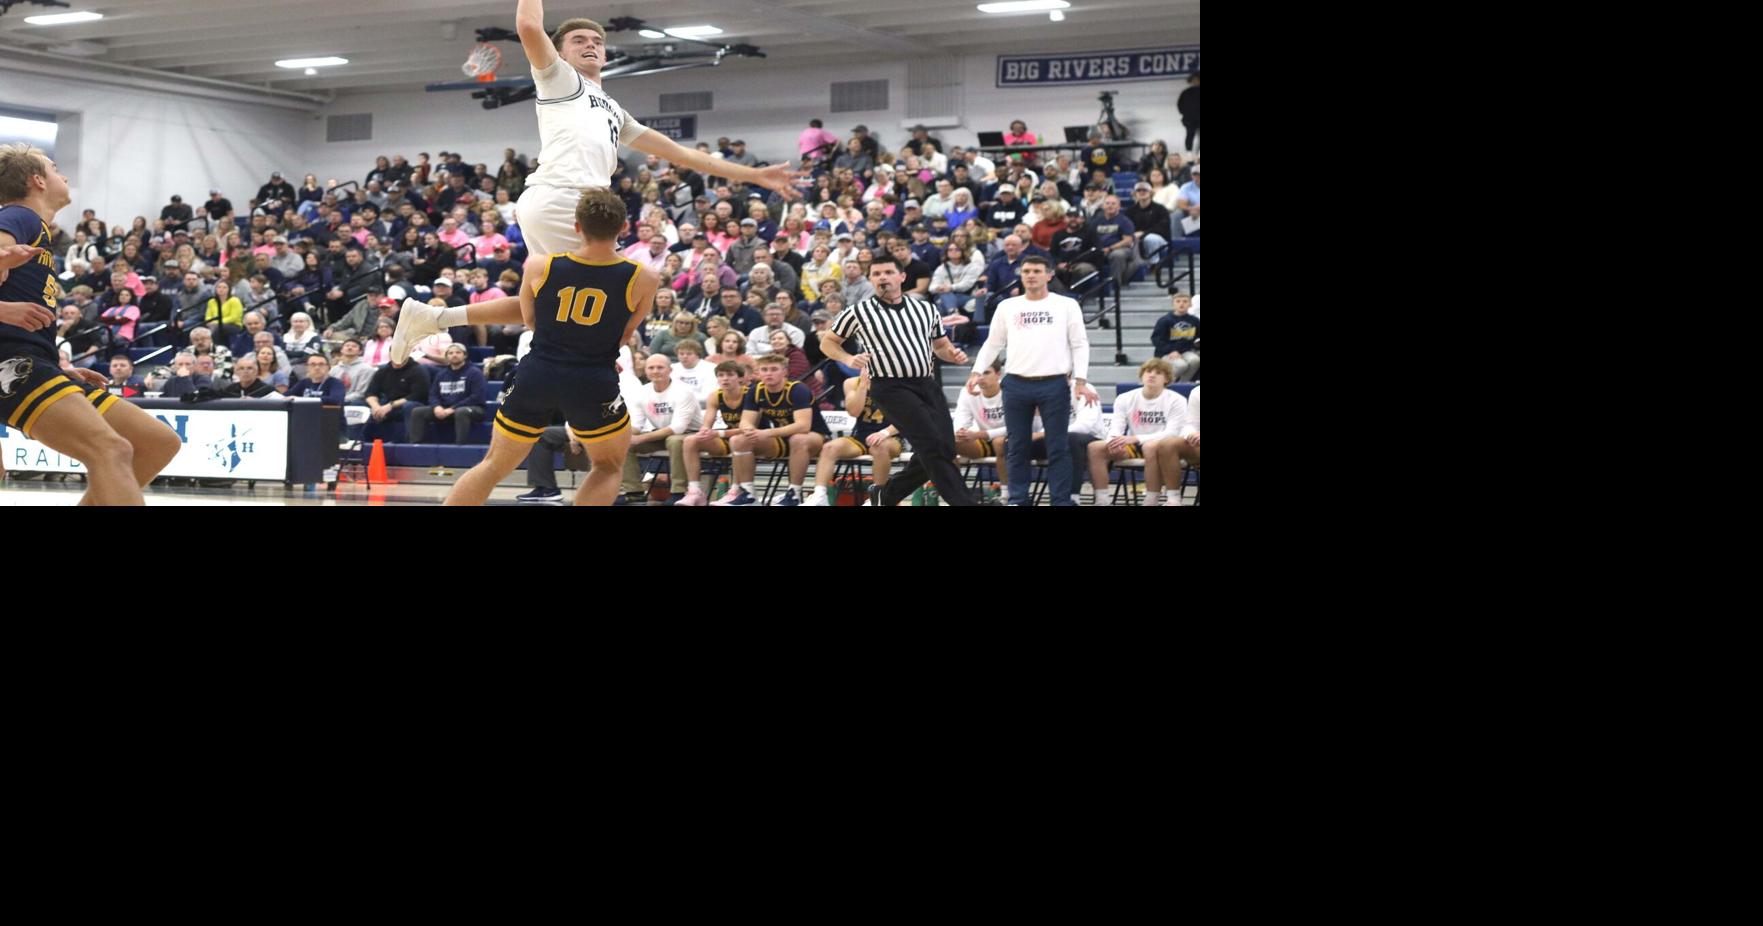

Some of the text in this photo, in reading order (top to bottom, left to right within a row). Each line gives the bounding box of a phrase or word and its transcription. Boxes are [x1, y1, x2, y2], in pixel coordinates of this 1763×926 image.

[1006, 52, 1200, 80] BIG RIVERS CONF
[43, 274, 57, 308] 5
[556, 286, 608, 326] 10
[1023, 316, 1054, 324] HOPE
[242, 442, 254, 453] H
